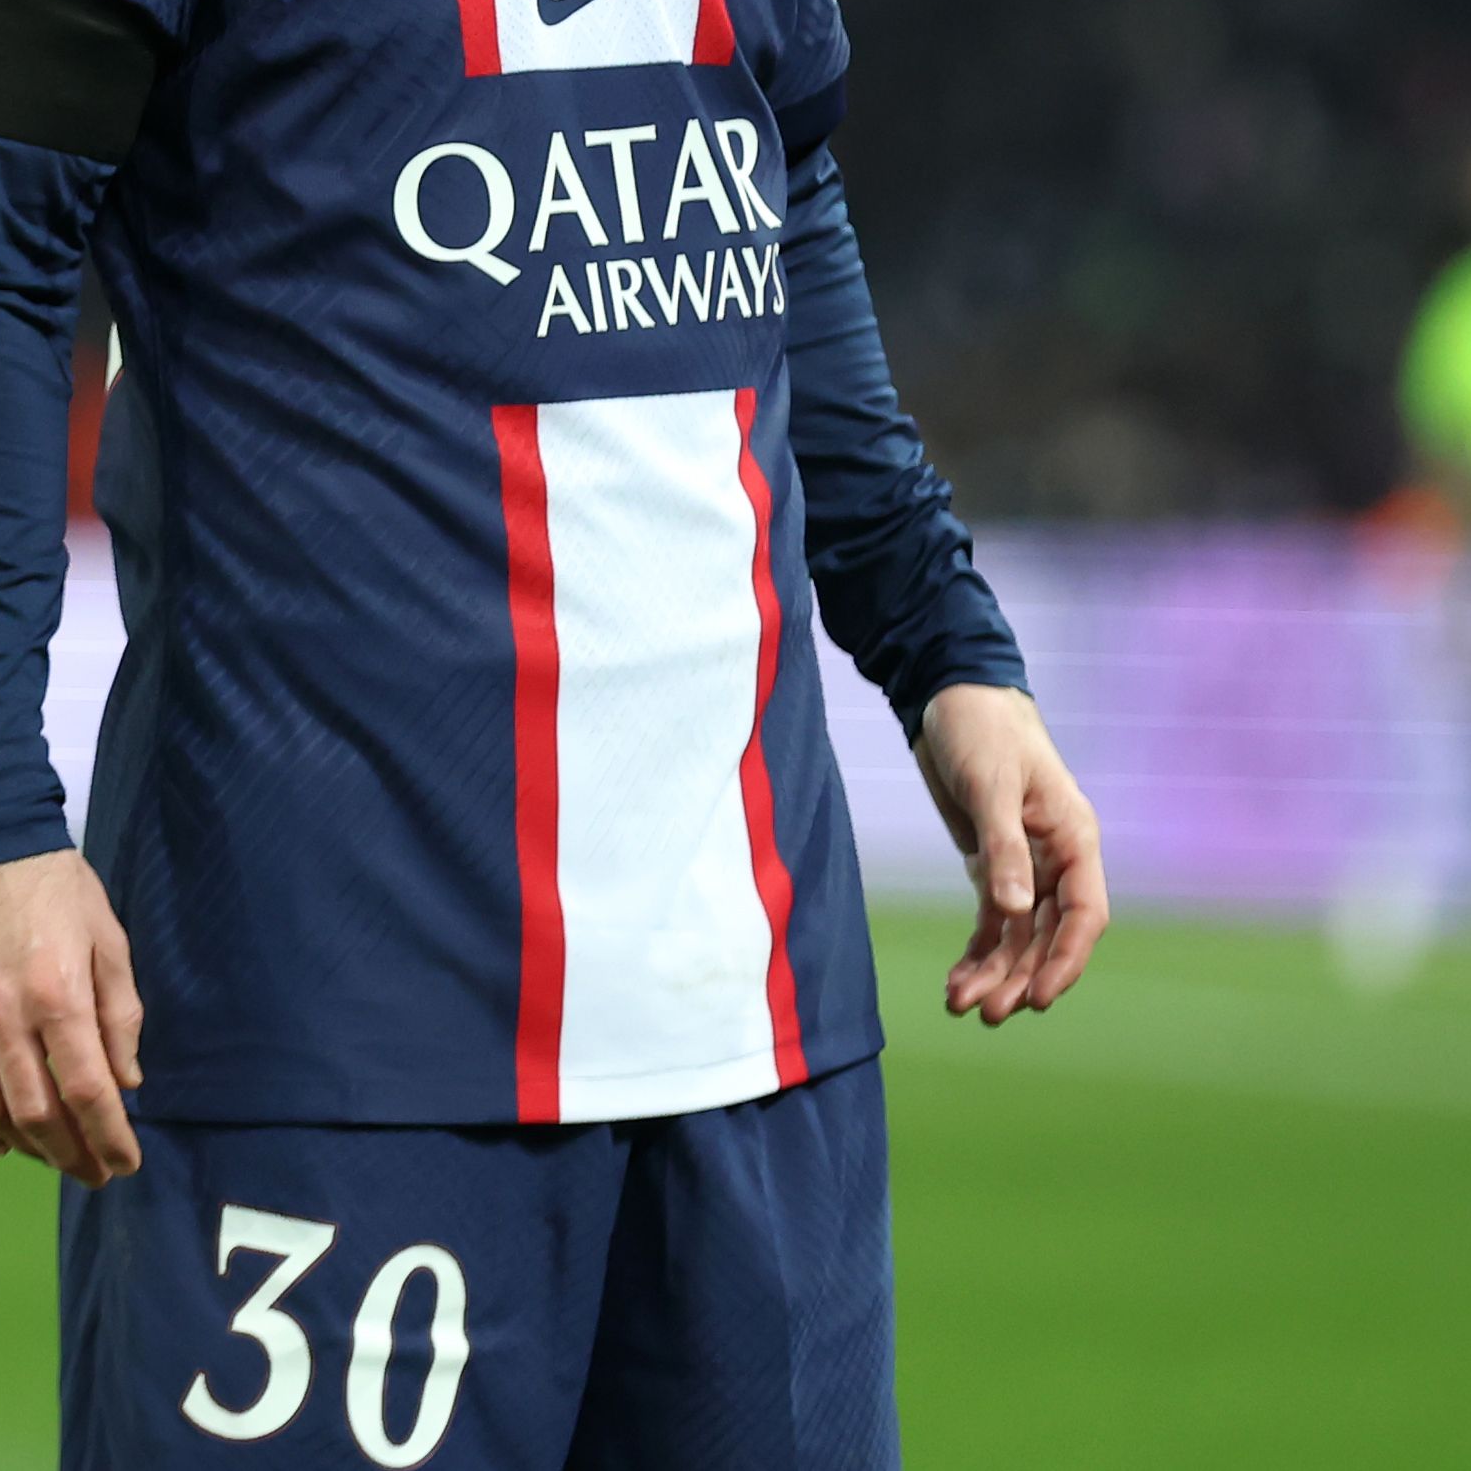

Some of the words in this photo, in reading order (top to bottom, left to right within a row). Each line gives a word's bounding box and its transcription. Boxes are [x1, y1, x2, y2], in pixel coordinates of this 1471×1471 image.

[393, 118, 783, 287] QATAR
[537, 242, 786, 338] AIRWAYS
[181, 1203, 470, 1469] 30
